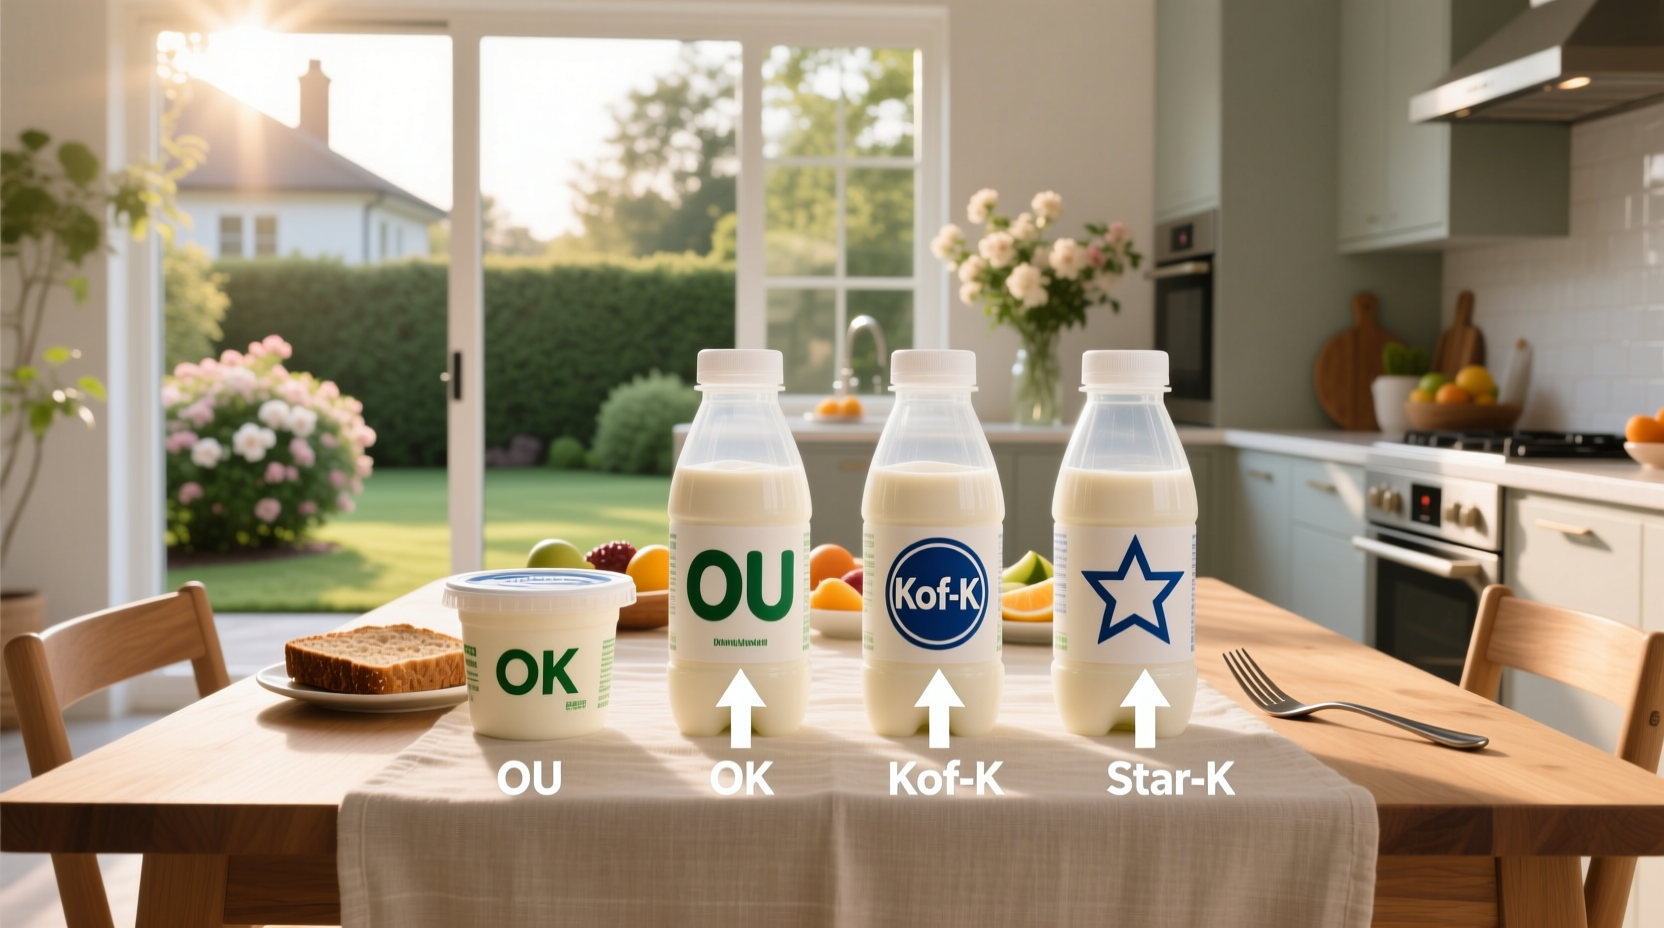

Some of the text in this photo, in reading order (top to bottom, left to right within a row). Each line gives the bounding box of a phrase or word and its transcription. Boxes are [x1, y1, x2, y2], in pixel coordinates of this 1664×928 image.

[686, 549, 795, 622] OU
[894, 576, 981, 610] Kof-K
[496, 648, 579, 695] OK
